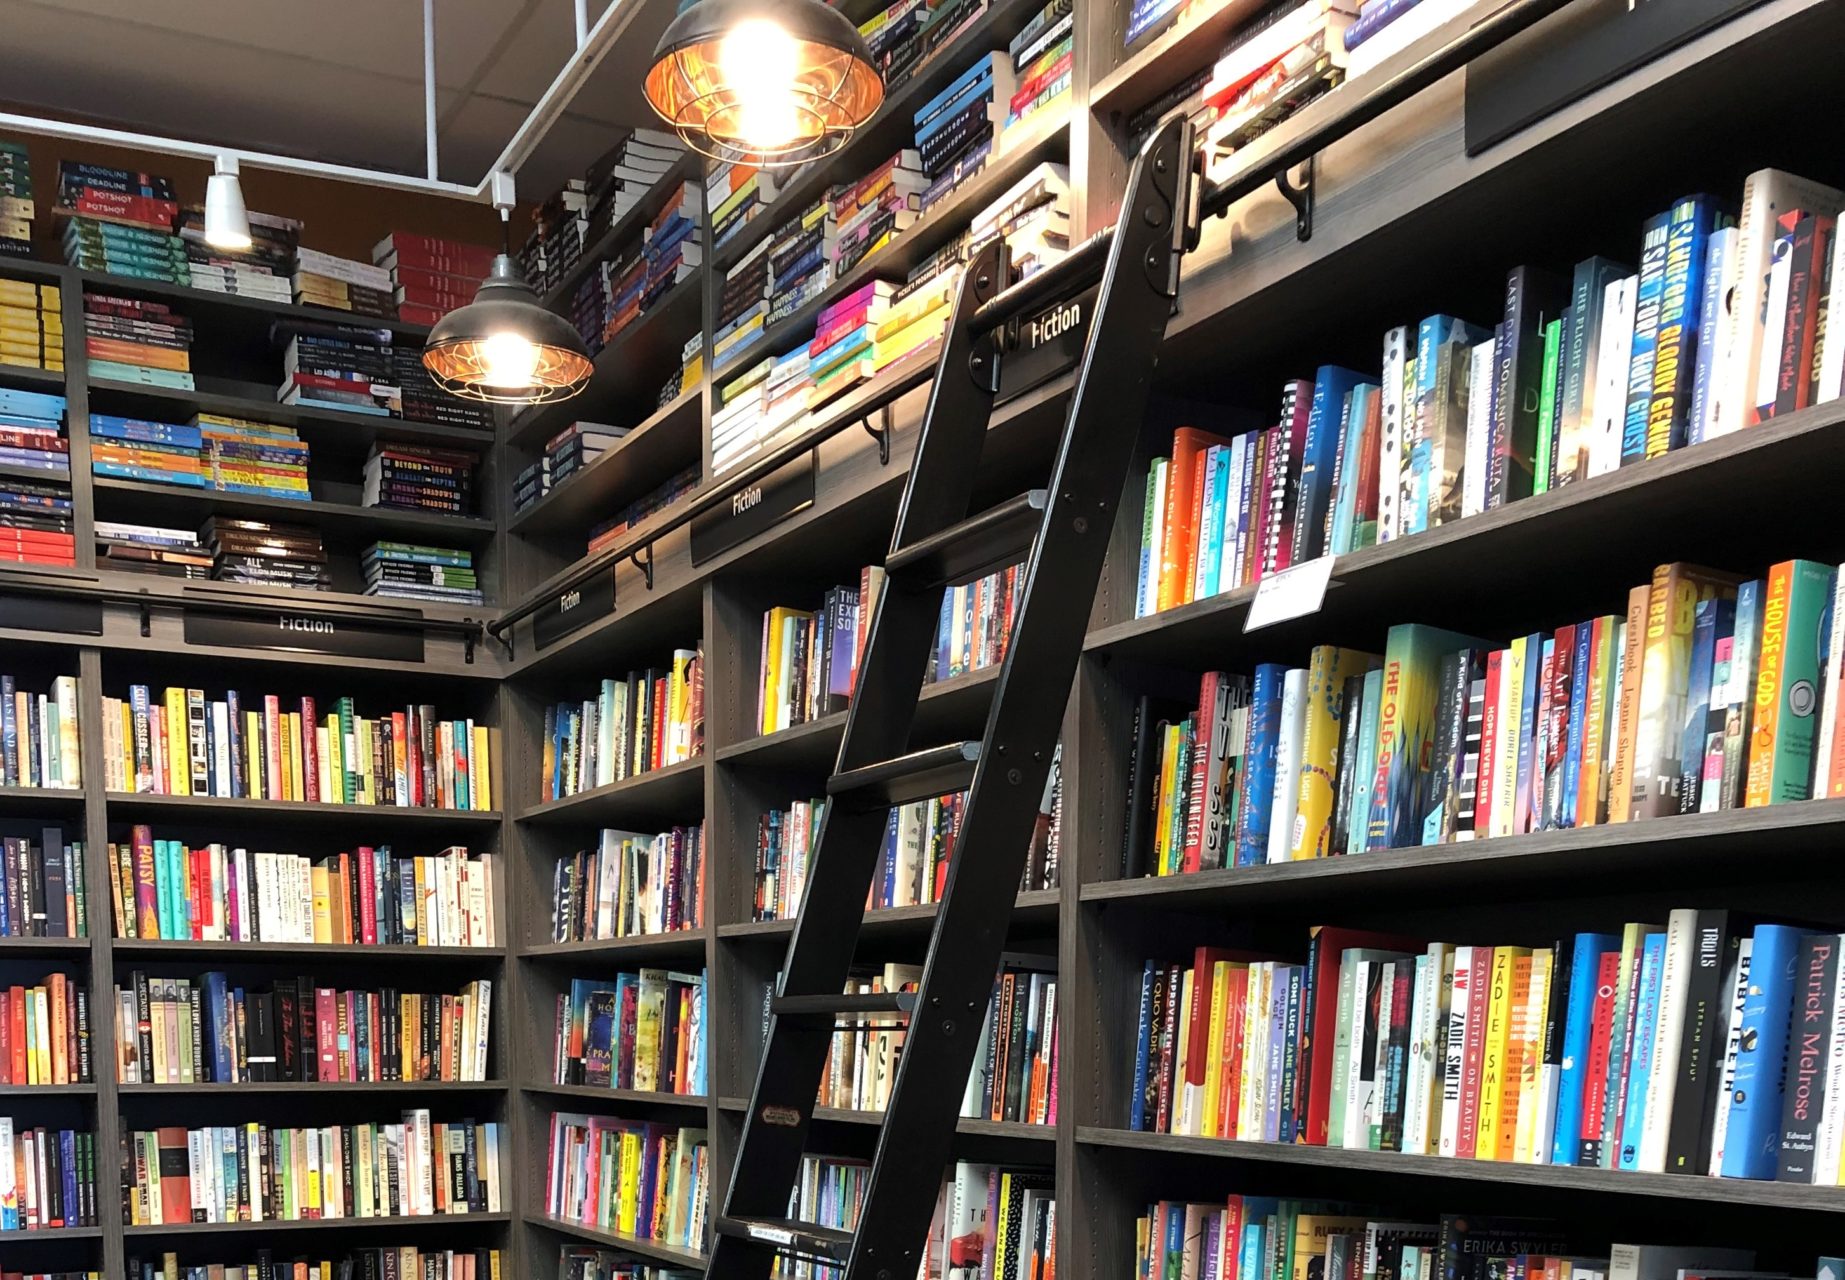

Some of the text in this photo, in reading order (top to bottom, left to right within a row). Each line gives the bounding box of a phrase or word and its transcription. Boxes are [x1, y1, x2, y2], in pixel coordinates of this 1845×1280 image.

[79, 165, 127, 179] BLOODLINE
[88, 178, 126, 190] DEADLINE
[86, 203, 126, 215] POTSHOT
[93, 191, 132, 203] POTSHOT
[1505, 276, 1518, 313] LAST
[1576, 283, 1588, 314] THE
[1635, 248, 1666, 341] SANDFORD
[1032, 302, 1080, 349] Fiction
[1502, 319, 1516, 350] DAY
[1571, 319, 1586, 370] FLIGHT
[1630, 349, 1655, 396] HOLY
[1495, 357, 1511, 447] DOMENICA
[1622, 398, 1649, 458] GHOST
[395, 460, 452, 474] BEYOND TRUTH
[422, 487, 453, 499] SHADOWS
[733, 487, 761, 516] Fiction
[270, 570, 293, 578] MUSK
[1773, 575, 1785, 595] THE
[560, 591, 580, 613] Fiction
[1648, 564, 1671, 639] BARBED
[280, 616, 334, 634] Fiction
[1763, 599, 1785, 655] HOUSE
[136, 687, 147, 710] CLIVE
[1386, 662, 1400, 696] THE
[1456, 666, 1465, 689] Kind
[1456, 691, 1463, 703] of
[1618, 605, 1642, 787] Guestbook Leanne Shapton
[1758, 671, 1776, 707] GOD
[1251, 697, 1260, 740] ISLAND
[1379, 704, 1396, 748] OLD
[1450, 703, 1462, 749] Freedom
[1250, 743, 1256, 757] OF
[1479, 705, 1495, 806] HOPE NEVER DIES
[1186, 742, 1208, 848] THE VOLUNTEER
[1243, 788, 1252, 831] WOMEN
[138, 845, 154, 888] PATSY
[1700, 927, 1719, 969] TROLLS
[139, 982, 148, 1022] SPECTATORS
[1150, 982, 1162, 1055] QUO VADIS
[1164, 969, 1178, 1057] IMPROVEMENT
[991, 1009, 999, 1051] OUTCASTS
[1282, 976, 1299, 1112] SOME LUCK JANE SMILEY
[1333, 972, 1351, 1092] Ali Smith Spring
[1444, 968, 1469, 1102] NW ZADIE SMITH
[1480, 955, 1506, 1134] ZADIE SMITH
[1724, 956, 1751, 1094] BABY TEETH
[1794, 944, 1830, 1122] Patrick Melrose
[1461, 961, 1486, 1142] ZADIE SMITH ON BEAUTY
[1268, 1042, 1280, 1113] JANE SMILEY
[455, 1154, 464, 1201] HANS FALLADA
[386, 1252, 394, 1269] KEN
[1464, 1239, 1506, 1254] ERIKA
